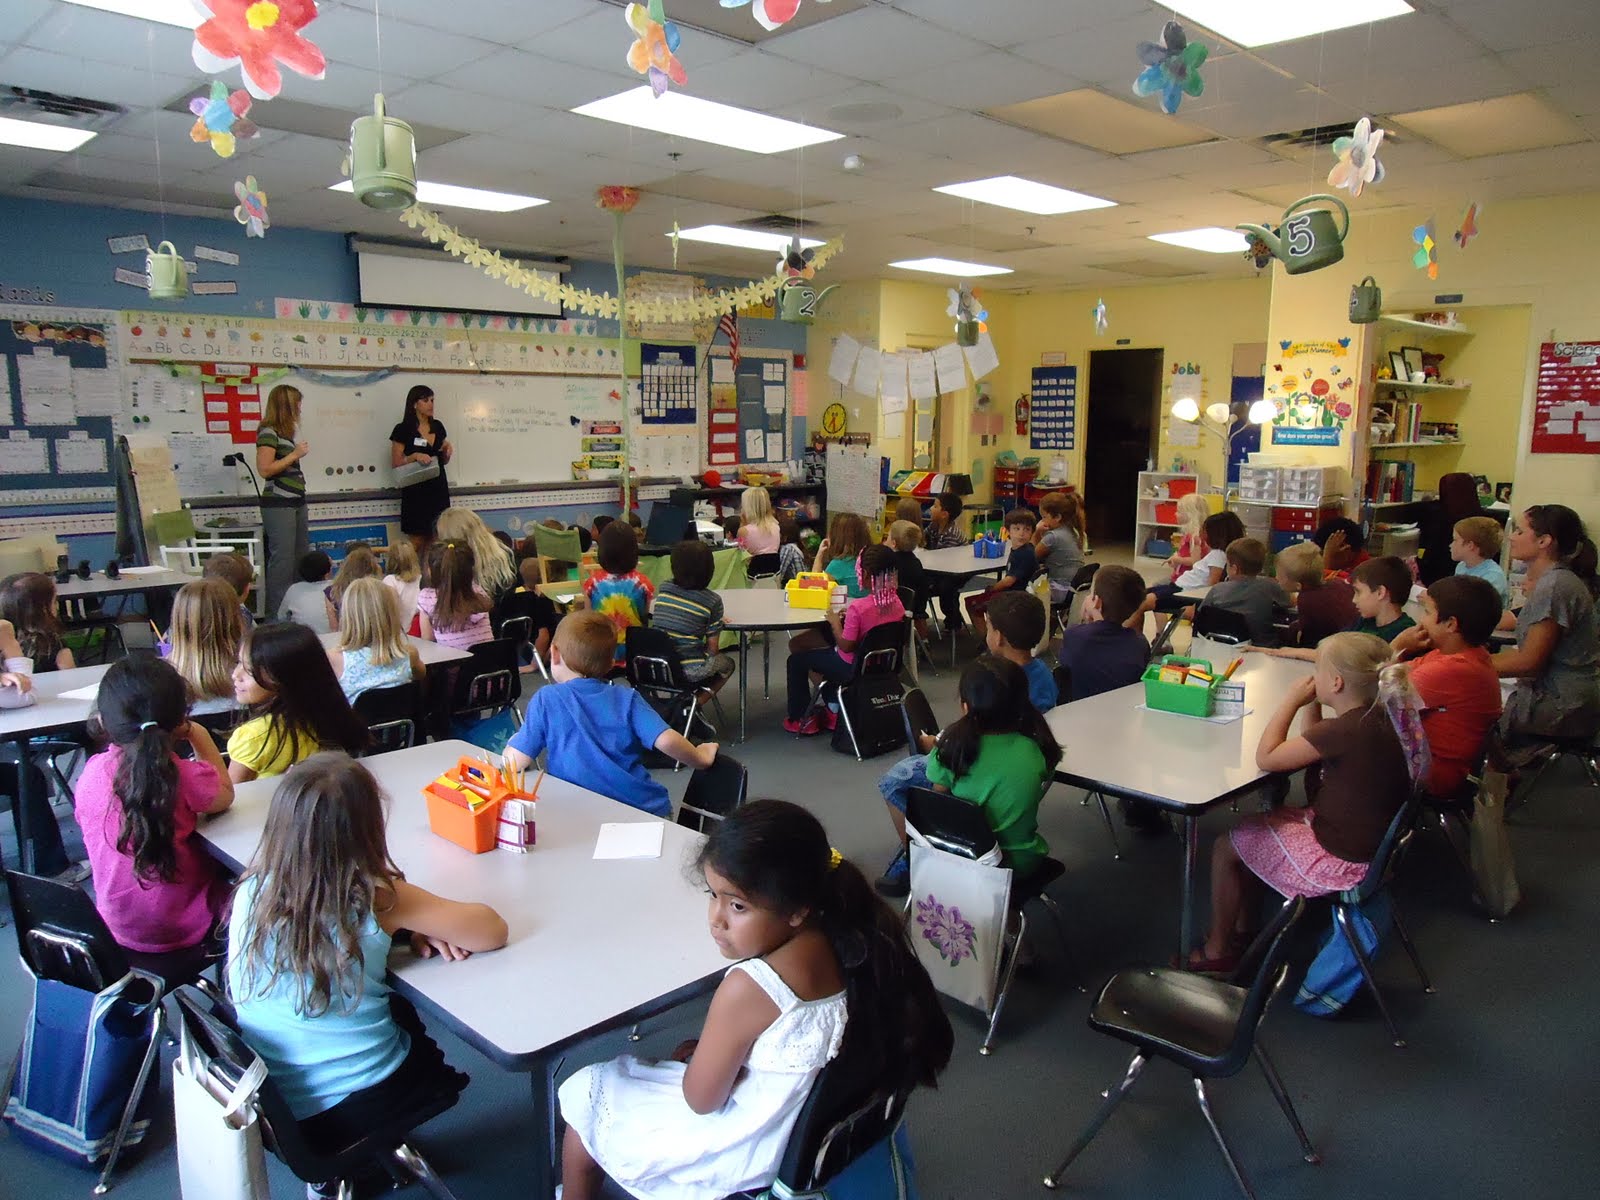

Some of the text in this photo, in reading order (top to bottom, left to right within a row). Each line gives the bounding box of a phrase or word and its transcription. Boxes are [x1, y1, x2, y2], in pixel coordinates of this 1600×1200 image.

[1287, 215, 1315, 257] 5
[799, 290, 817, 317] 2
[155, 341, 172, 353] Bb
[180, 342, 196, 354] Cc
[203, 343, 221, 355] Dd
[272, 347, 288, 362] Gg
[294, 347, 309, 359] Hh
[393, 351, 411, 362] Mm
[1171, 362, 1200, 375] Jobs
